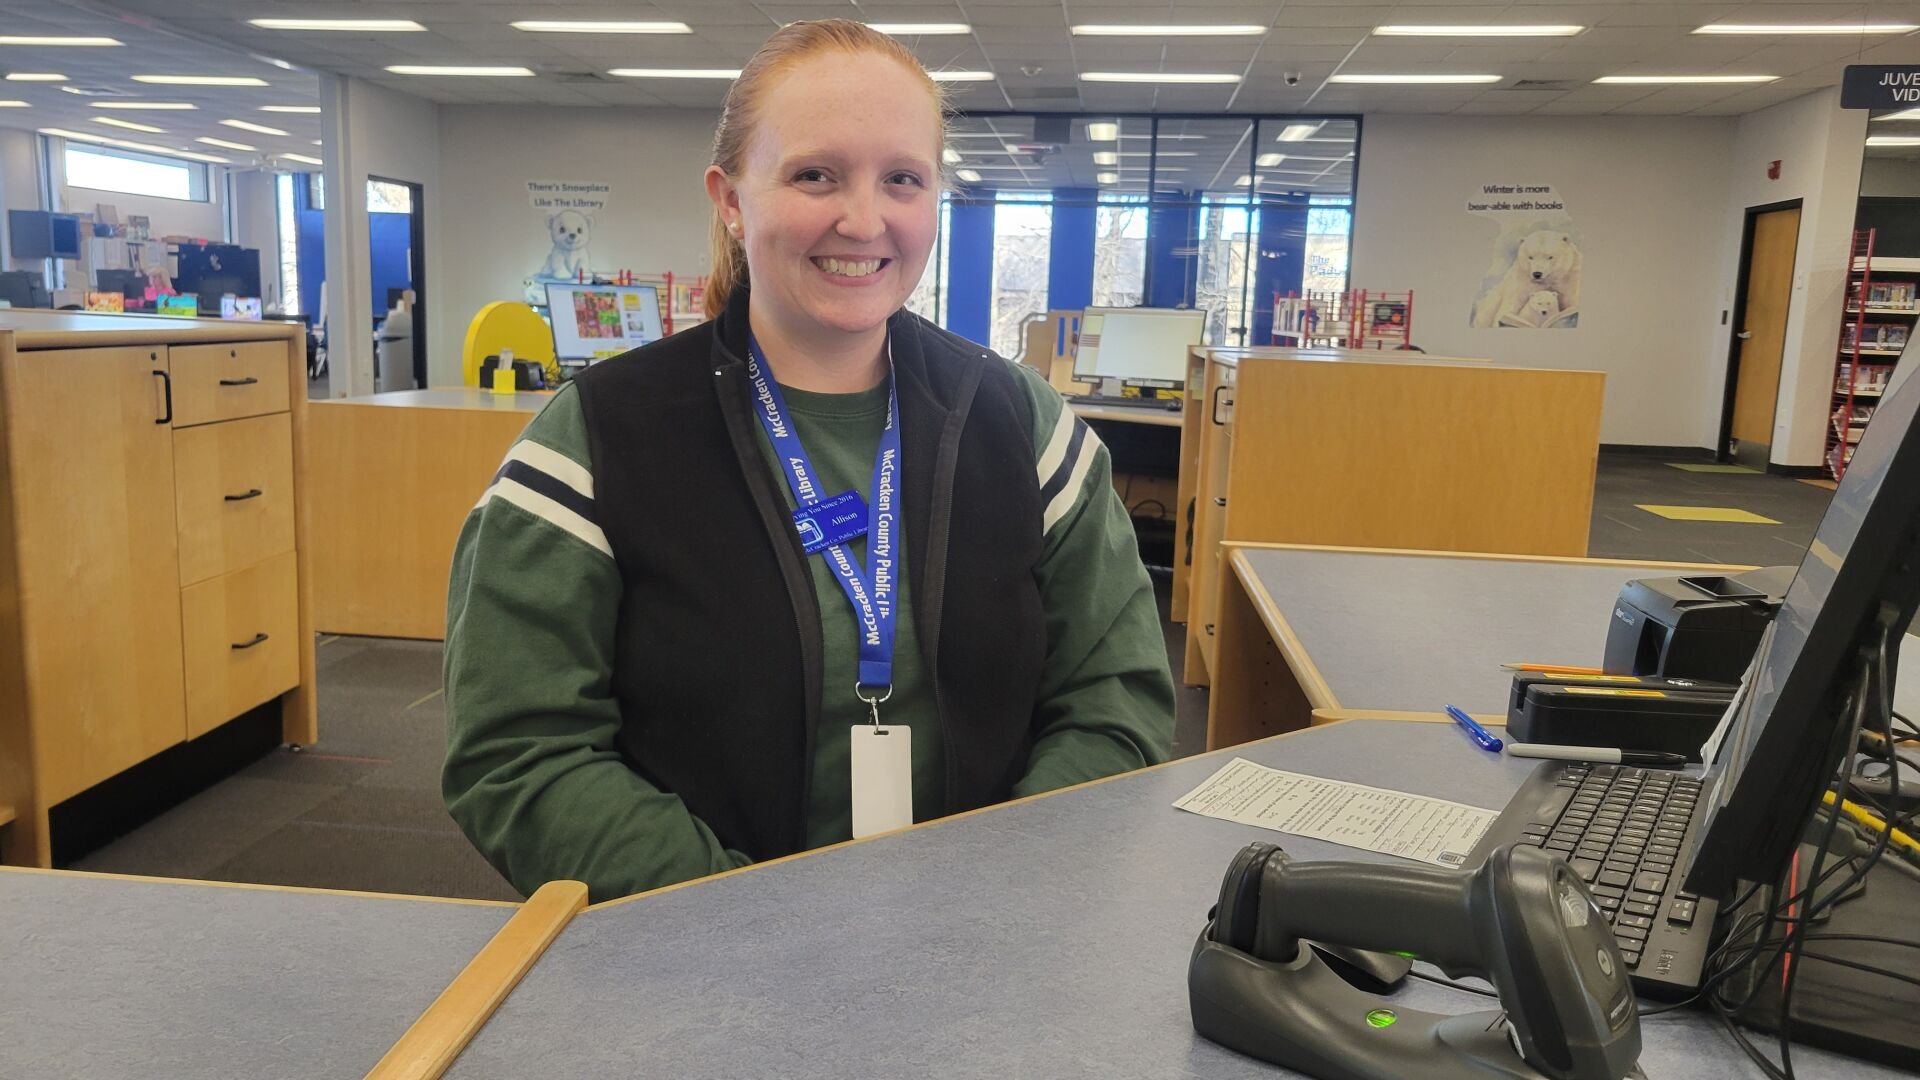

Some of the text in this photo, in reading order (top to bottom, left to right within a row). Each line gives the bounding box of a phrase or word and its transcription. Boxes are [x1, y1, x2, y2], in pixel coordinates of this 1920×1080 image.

[1892, 88, 1920, 102] VID
[528, 182, 609, 193] There's Snowplace
[1483, 185, 1515, 194] Winter
[1516, 185, 1523, 194] is
[534, 198, 604, 209] Like The Library
[1468, 201, 1563, 211] bear-able with books
[755, 378, 788, 438] McCracken
[789, 457, 817, 500] Library
[878, 449, 895, 511] McCracken
[831, 512, 858, 526] Allison
[874, 513, 893, 557] County
[875, 559, 891, 598] Public
[828, 545, 880, 646] McCracken Count
